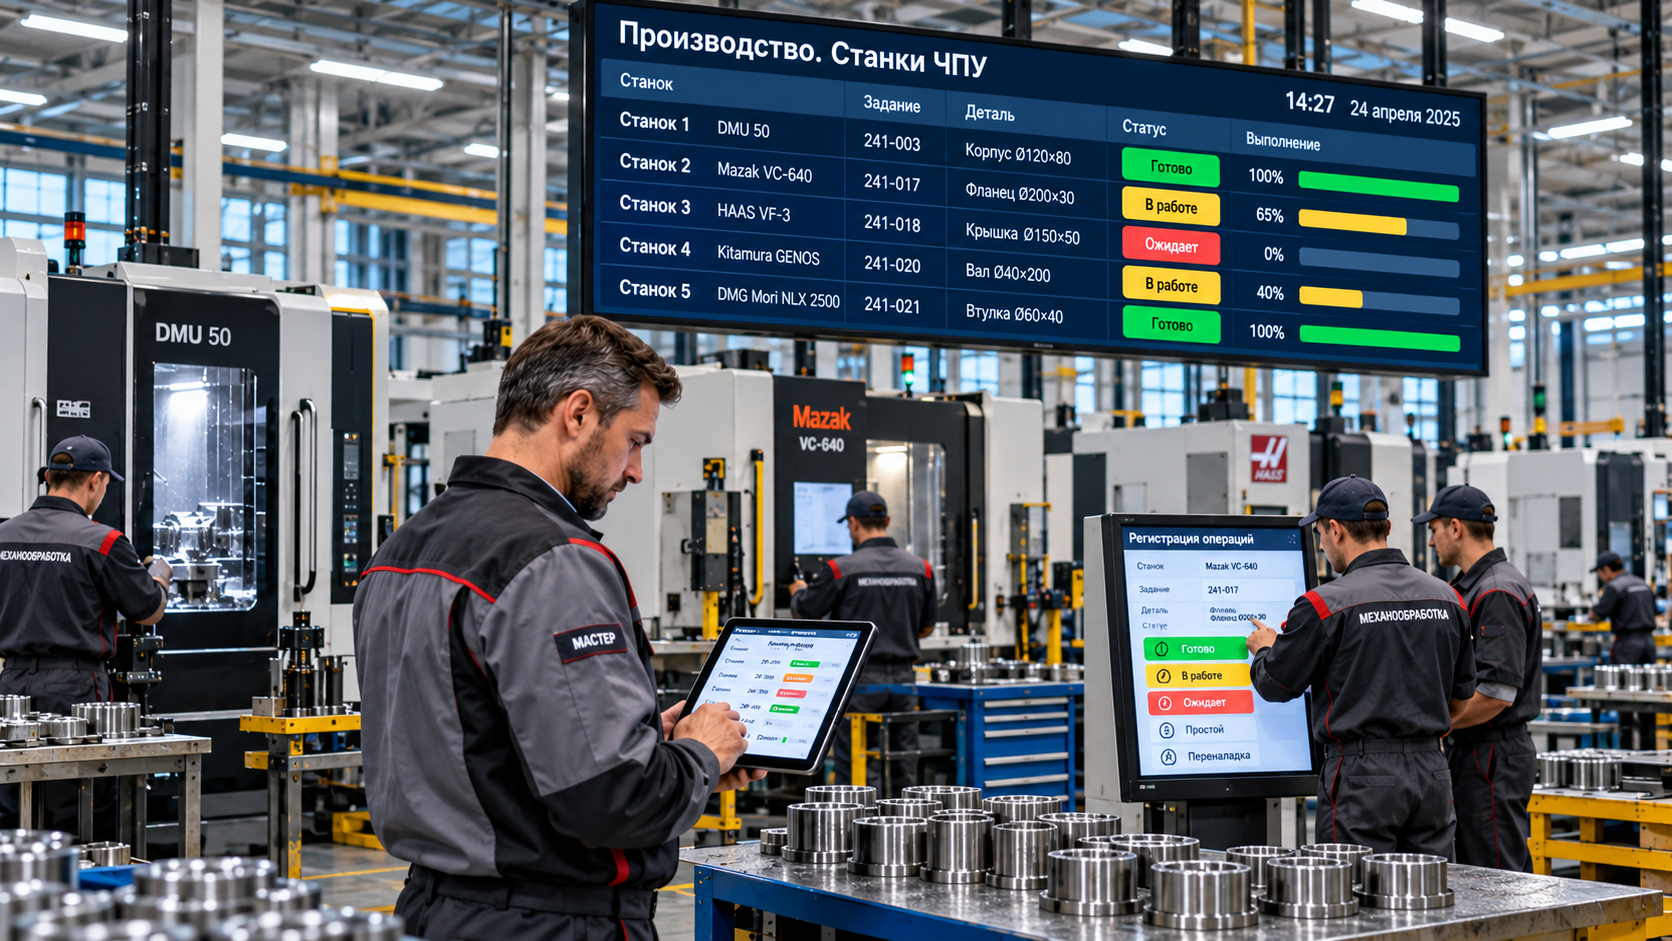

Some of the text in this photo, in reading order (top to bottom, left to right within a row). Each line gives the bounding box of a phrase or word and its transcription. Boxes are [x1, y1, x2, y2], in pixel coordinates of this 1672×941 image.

[619, 19, 987, 79] Производство. Станки ЧПУ
[619, 72, 674, 91] Станок
[863, 94, 921, 115] Задание
[1285, 90, 1335, 114] 14:27
[619, 111, 690, 132] Станок 1
[964, 104, 1015, 123] Деталь
[1349, 99, 1461, 128] 24 апреля 2025
[717, 120, 770, 139] DMU 50
[1122, 119, 1167, 137] Статус
[863, 132, 921, 152] 241-003
[1245, 131, 1321, 152] Выполнение
[965, 142, 1012, 163] Корпус
[619, 153, 691, 174] Станок 2
[717, 161, 813, 183] Mazak VC-640
[1150, 159, 1193, 176] Готово
[863, 174, 920, 193] 241-017
[1249, 167, 1284, 185] 100%
[965, 182, 1015, 202] Фланец
[619, 195, 691, 215] Станок 3
[717, 203, 790, 222] HAAS VF-3
[1145, 197, 1198, 218] В работе
[863, 214, 921, 233] 241-018
[1256, 207, 1284, 224] 65%
[965, 222, 1018, 241] Крышка
[619, 237, 691, 257] Станок 4
[1144, 236, 1199, 255] Ожидает
[1264, 246, 1284, 262] 0%
[717, 245, 820, 266] Kitamura GENOS
[863, 255, 921, 274] 241-020
[965, 262, 990, 279] Вал
[619, 279, 691, 299] Станок 5
[1145, 276, 1198, 297] В работе
[1256, 284, 1284, 301] 40%
[717, 286, 840, 310] DMG Mori NLX 2500
[863, 296, 920, 315] 241-021
[966, 303, 1011, 322] Втулка
[1151, 316, 1194, 333] Готово
[1249, 323, 1285, 340] 100%
[155, 322, 232, 347] DMU 50
[793, 404, 852, 431] Mazak
[799, 436, 845, 452] VC-640
[1129, 532, 1254, 546] Регистрация операций
[1136, 562, 1165, 570] Станок
[1205, 562, 1258, 571] Mazak VC-640
[1138, 585, 1170, 594] Задание
[1207, 586, 1239, 595] 241-017
[1359, 609, 1449, 624] МЕХАНООБРАБОТКА
[572, 632, 616, 650] МАСТЕР
[1181, 645, 1215, 653] Готово
[1182, 671, 1223, 682] В работе
[1183, 698, 1227, 708] Ожидает
[1185, 724, 1224, 737] Простой
[1188, 751, 1251, 763] Переналадка
